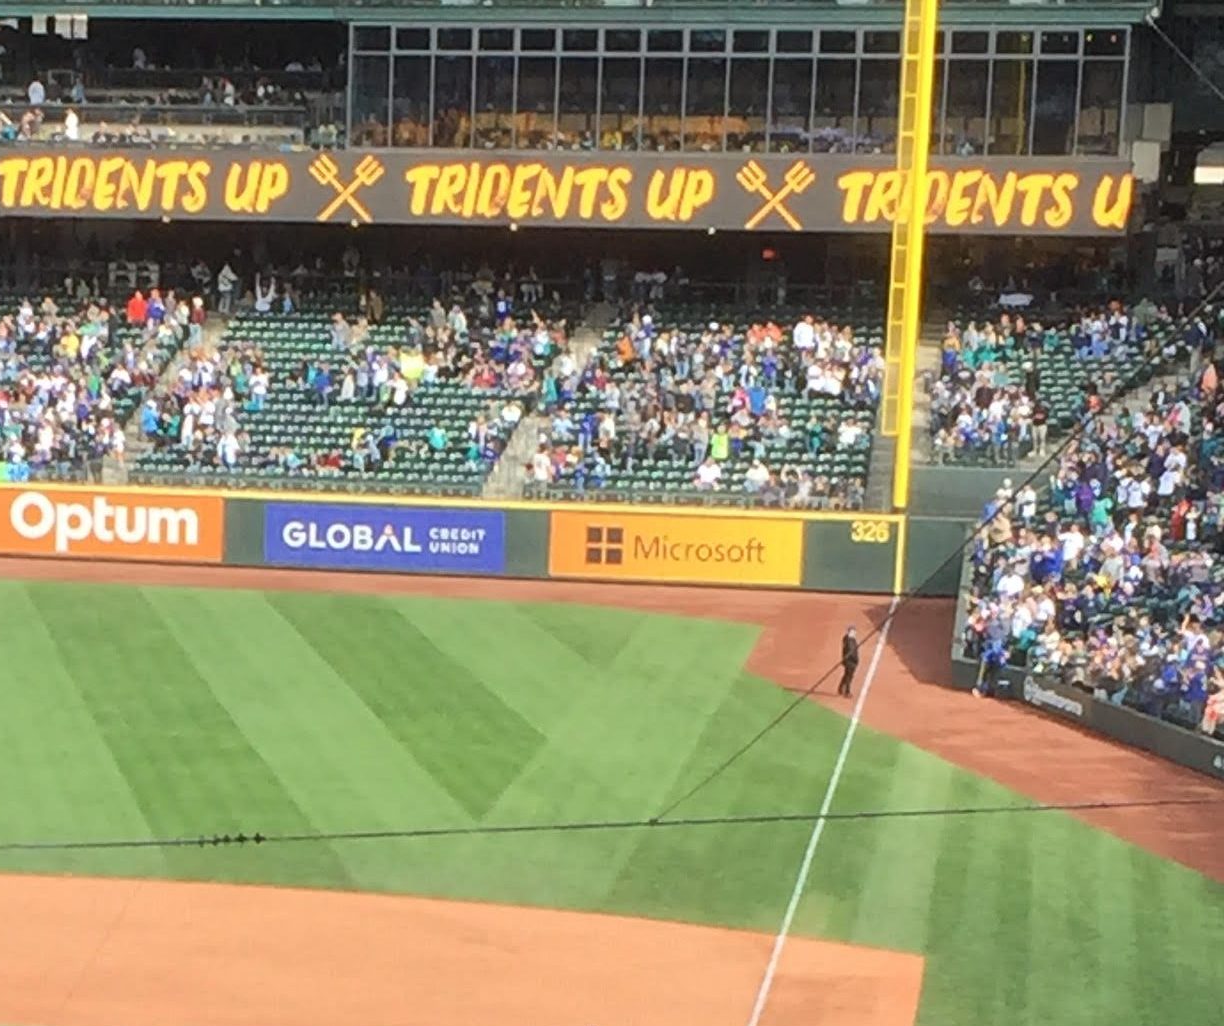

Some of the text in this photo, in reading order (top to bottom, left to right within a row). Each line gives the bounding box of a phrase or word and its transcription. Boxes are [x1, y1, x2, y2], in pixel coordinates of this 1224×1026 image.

[224, 161, 289, 213] UP
[405, 162, 714, 221] TRIDENTS UP
[10, 490, 198, 552] Optum
[428, 527, 486, 541] CREDIT
[850, 520, 889, 543] 326
[282, 521, 422, 553] GLOBAL
[429, 542, 480, 555] UNION
[633, 535, 766, 564] Microsoft
